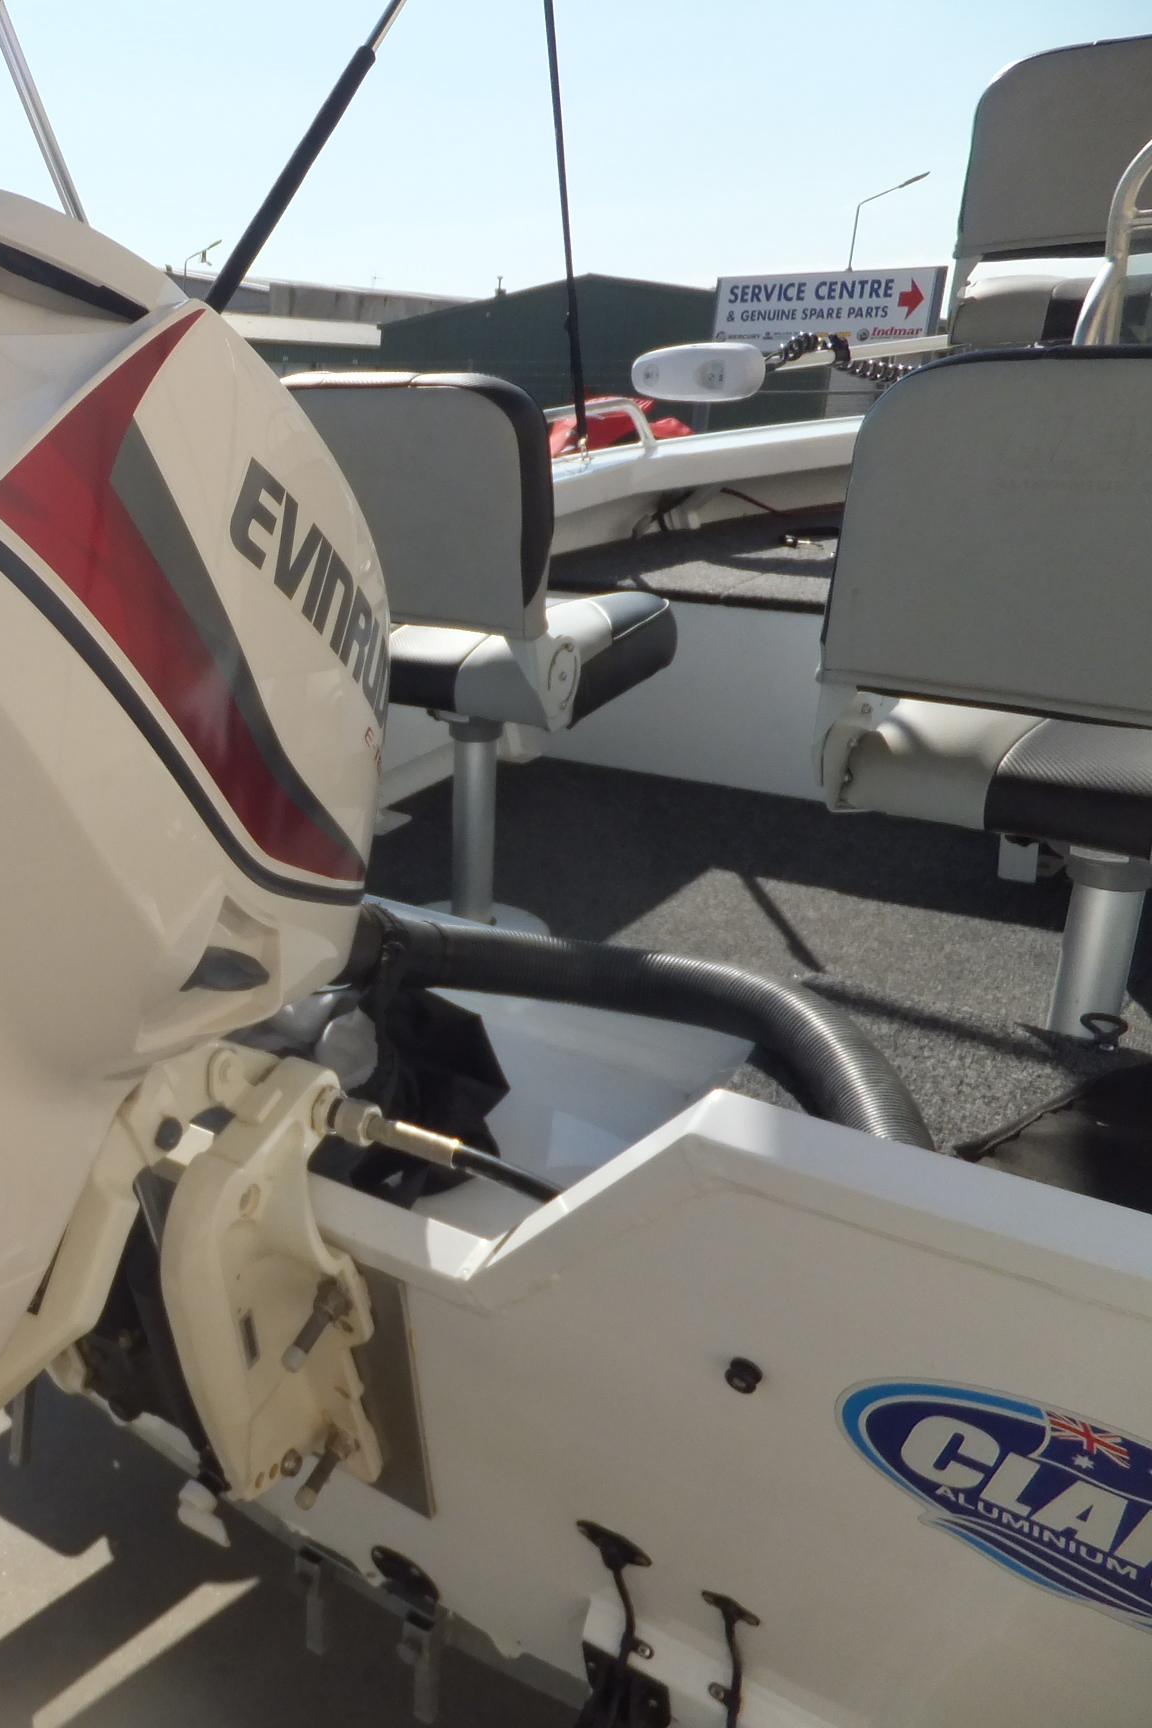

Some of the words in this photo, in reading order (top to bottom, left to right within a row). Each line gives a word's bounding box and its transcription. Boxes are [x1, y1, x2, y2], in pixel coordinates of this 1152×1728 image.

[728, 282, 806, 304] SERVICE
[814, 278, 895, 300] CENTRE
[726, 311, 735, 322] &
[741, 308, 797, 322] GENUINE
[801, 306, 842, 320] SPARE
[847, 305, 889, 319] PARTS
[871, 326, 922, 337] Indmar
[935, 1485, 1137, 1580] ALUMINIUM
